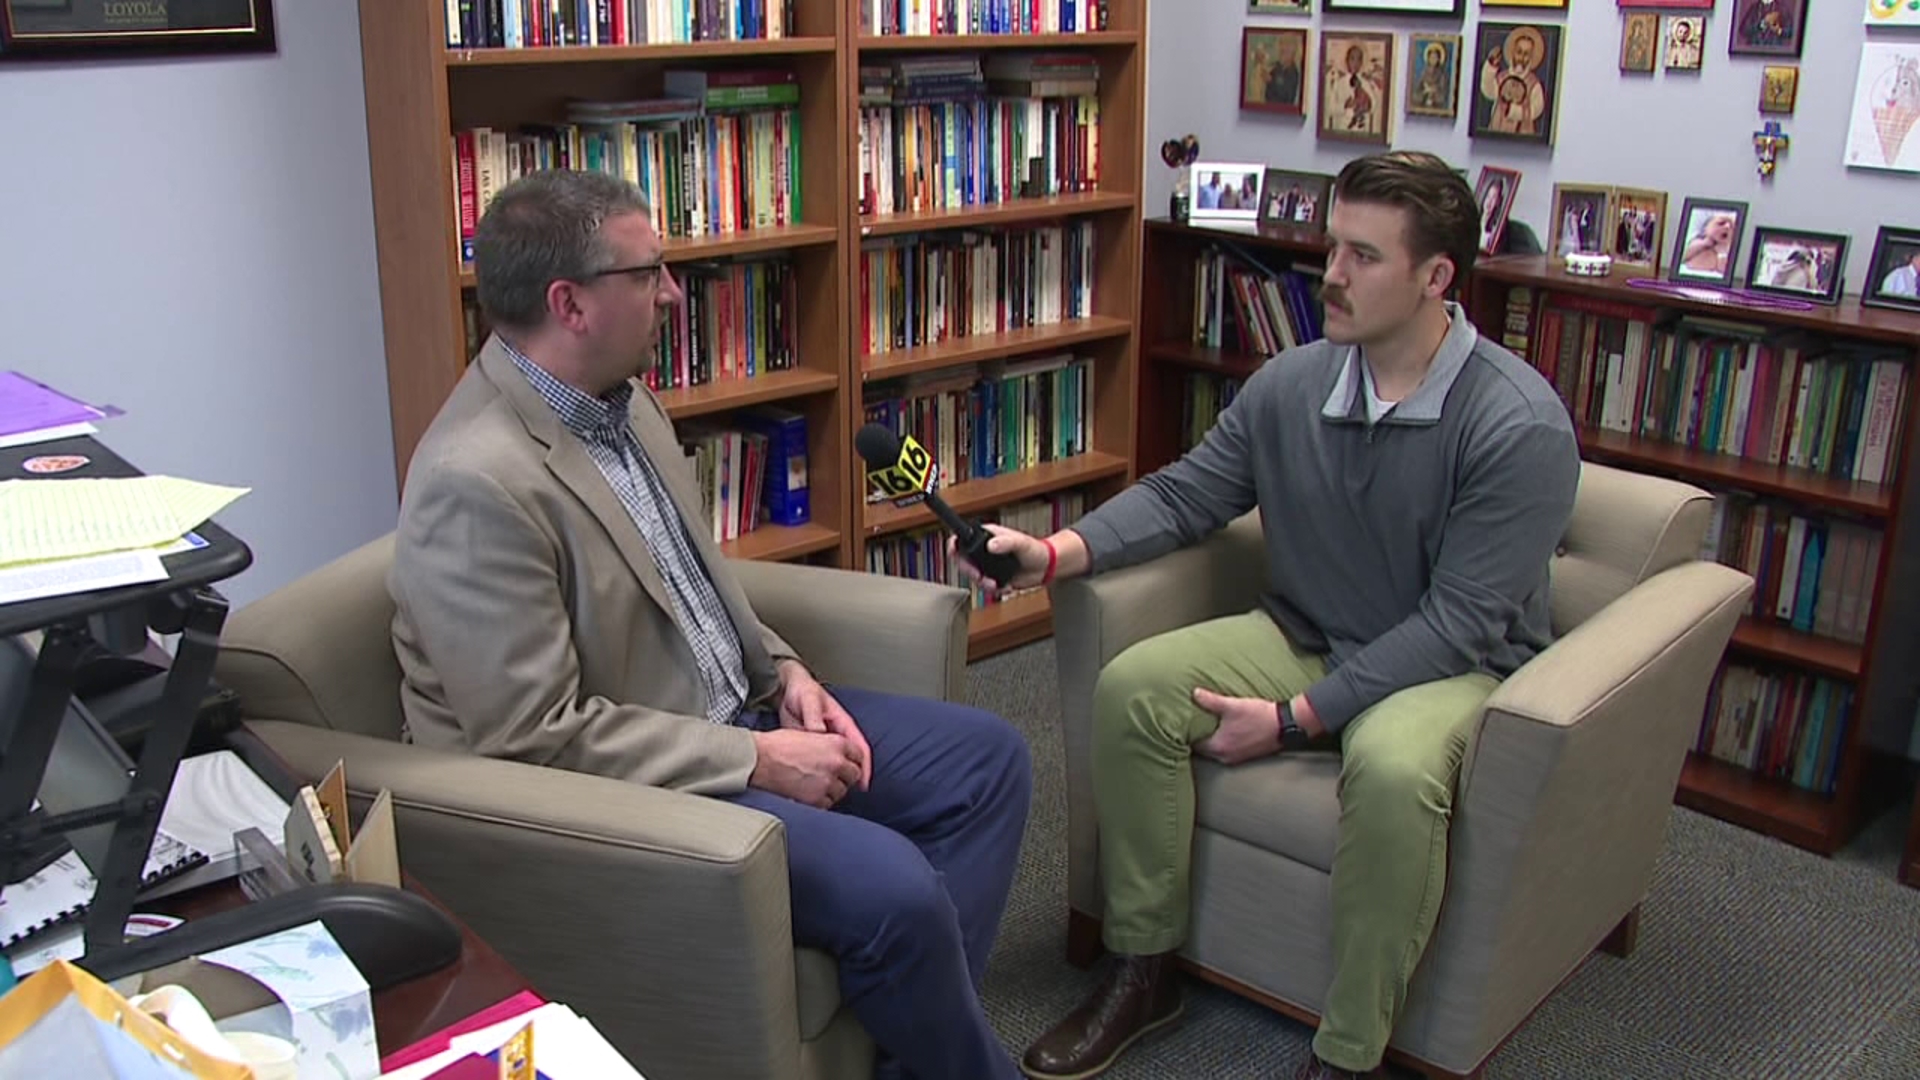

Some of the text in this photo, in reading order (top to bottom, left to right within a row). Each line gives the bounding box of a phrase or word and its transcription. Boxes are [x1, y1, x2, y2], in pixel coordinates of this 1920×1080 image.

[104, 2, 167, 17] LOYOLA
[901, 444, 927, 483] 16
[872, 469, 913, 496] 16
